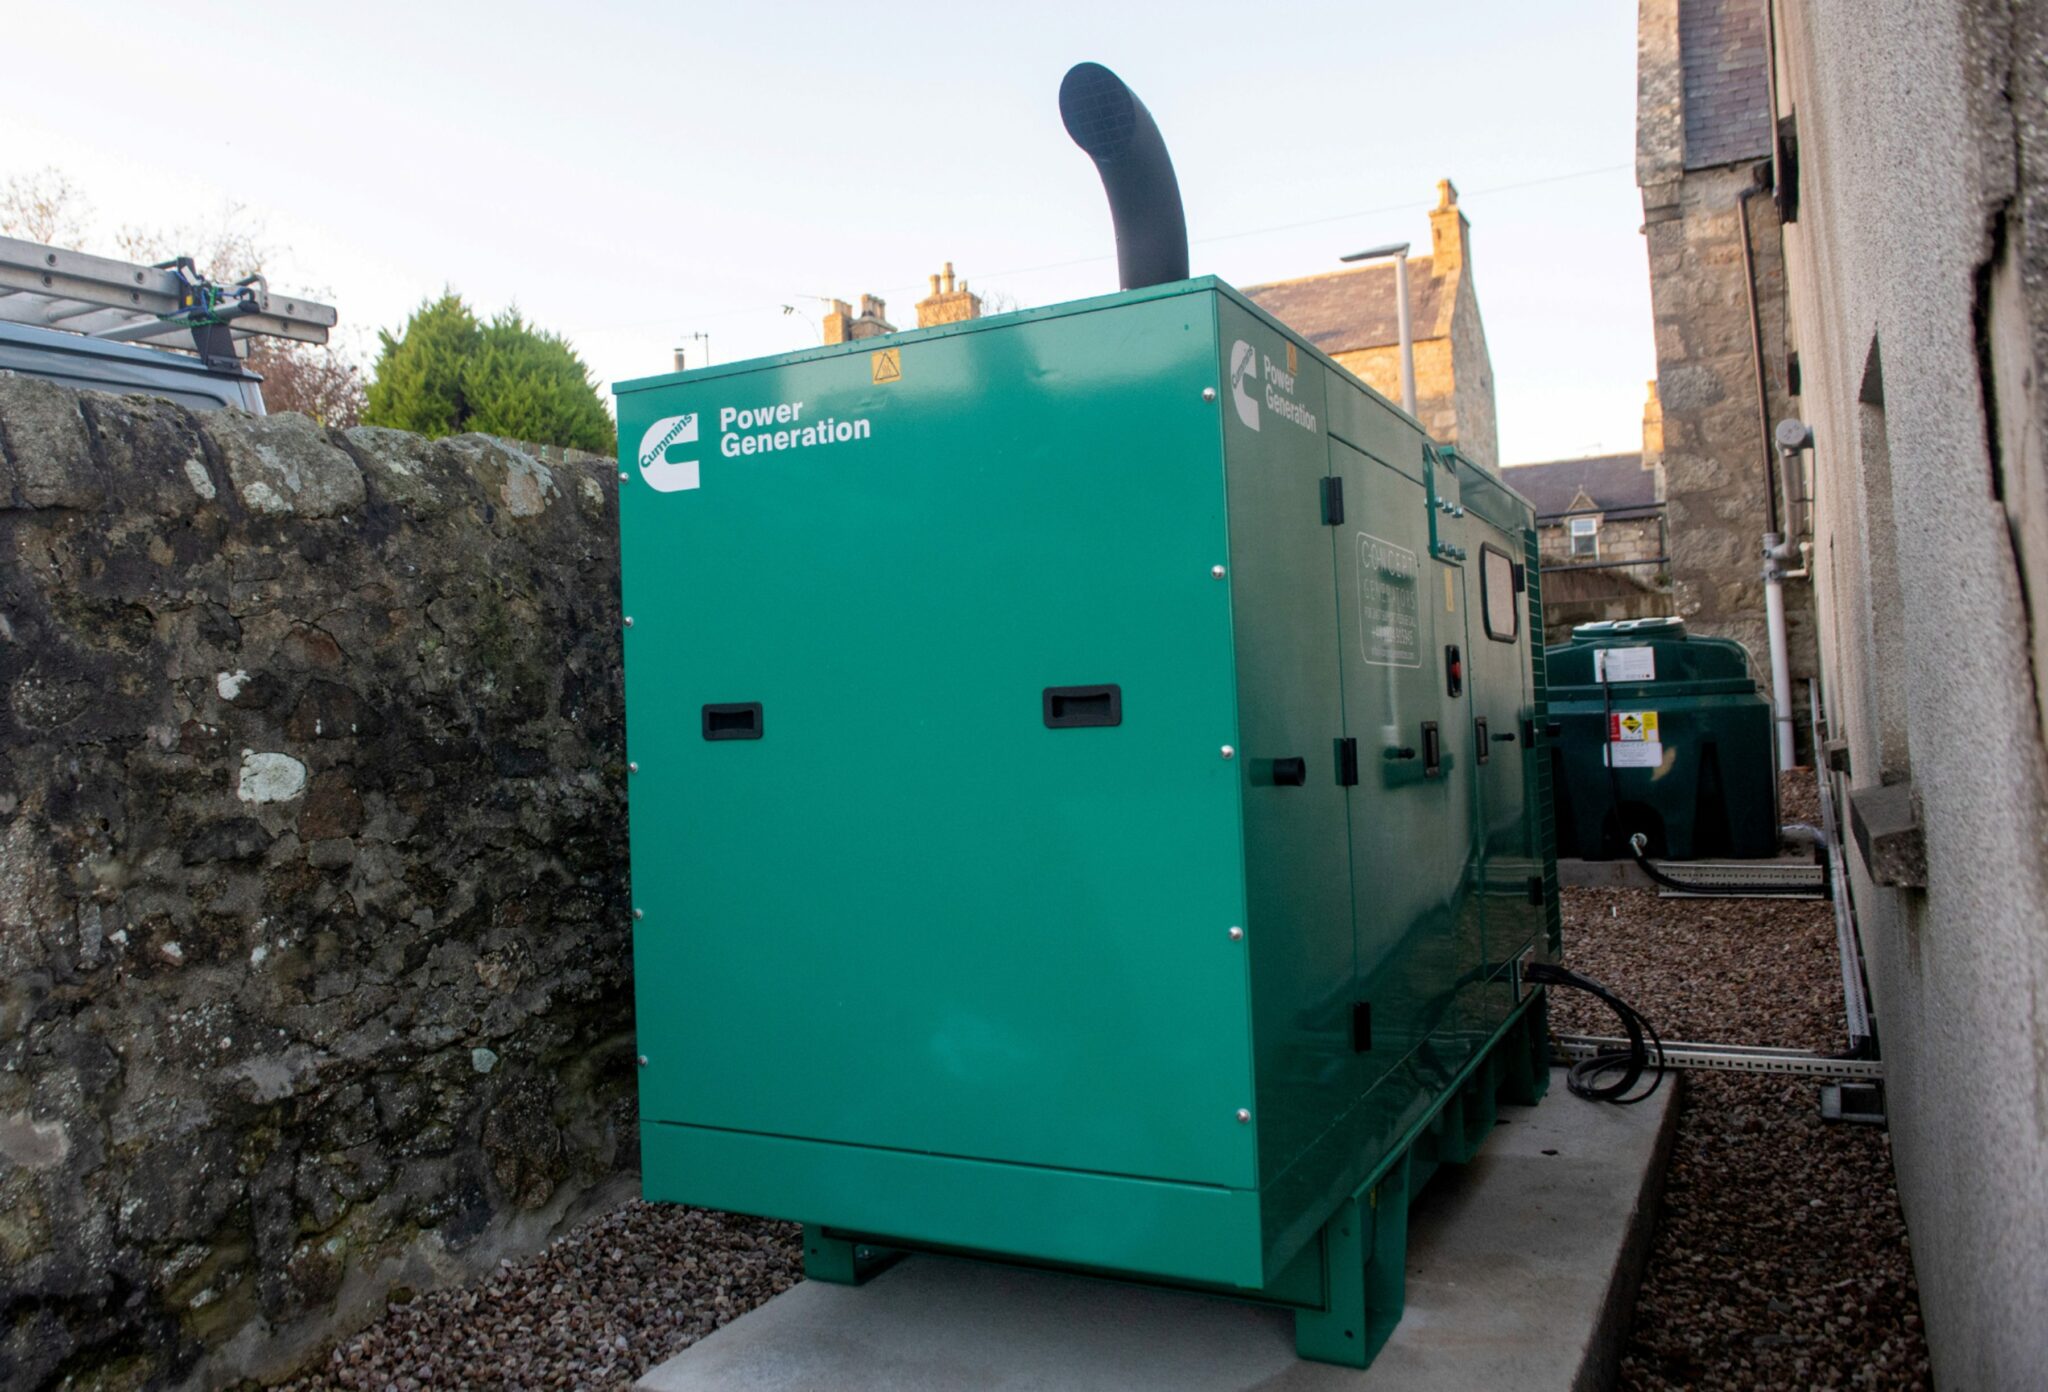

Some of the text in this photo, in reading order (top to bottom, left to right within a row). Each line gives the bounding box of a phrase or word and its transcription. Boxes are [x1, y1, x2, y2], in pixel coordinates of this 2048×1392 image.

[1264, 354, 1294, 395] Power
[720, 402, 803, 432] Power
[1266, 383, 1316, 433] Generation
[641, 415, 692, 468] Cummins
[720, 418, 871, 458] Generation
